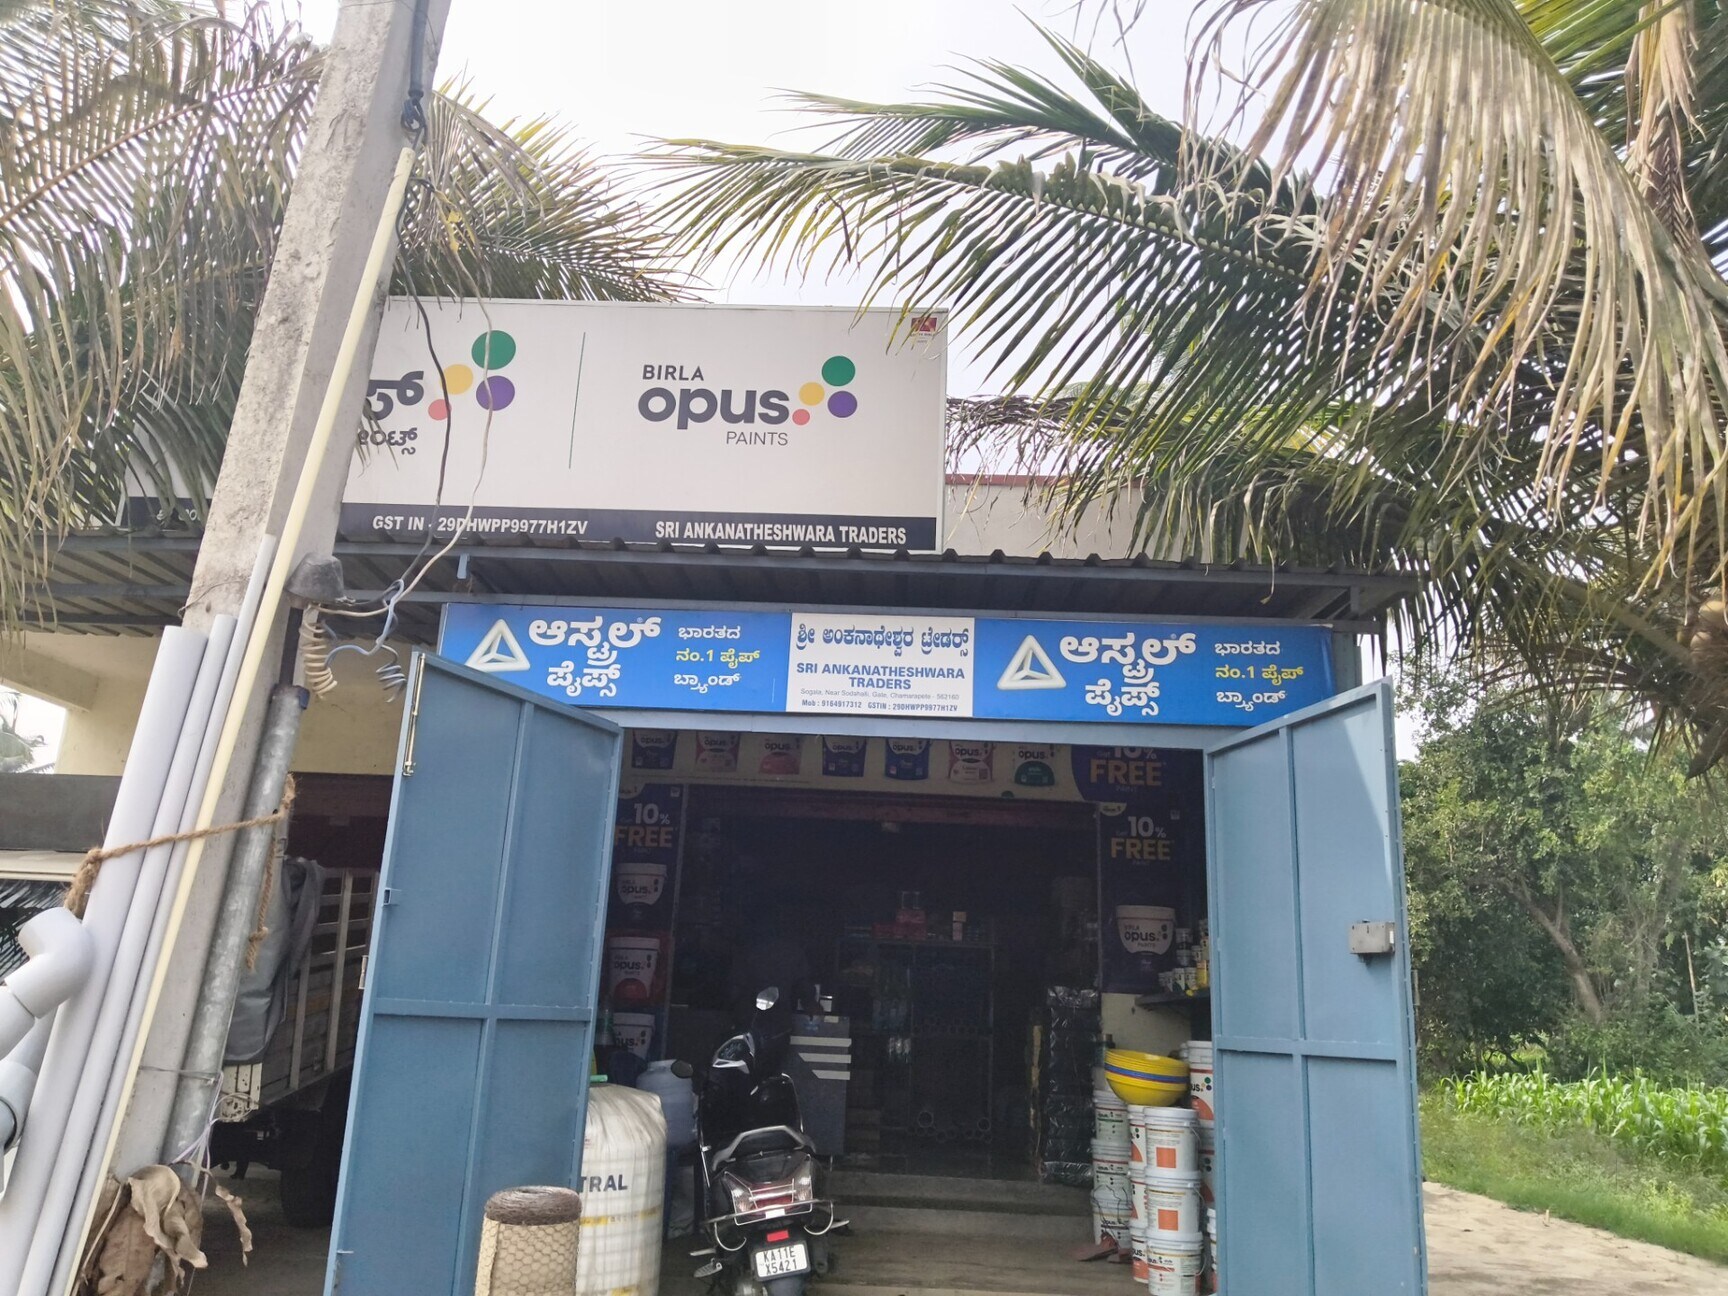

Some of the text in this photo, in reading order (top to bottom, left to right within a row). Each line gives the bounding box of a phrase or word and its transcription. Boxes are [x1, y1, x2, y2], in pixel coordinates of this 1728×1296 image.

[642, 364, 704, 382] BIRLA
[638, 385, 790, 430] opus
[725, 431, 789, 447] PAINTS
[372, 515, 404, 531] GST
[407, 516, 425, 531] IN
[655, 521, 907, 545] SRI ANKANATHESHWARA TRADERS
[528, 615, 662, 667] ಆಸ್ಟ್ರಲ್
[678, 625, 741, 640] ಭಾರತದ
[795, 623, 816, 651] ಶ್ರೀ
[822, 624, 914, 657] ಅಂಕನಾಥೇಶ್ವರ
[1214, 641, 1281, 655] ಭಾರತದ
[676, 648, 761, 670] ನಂ.1 ಪೈಪ್
[1059, 632, 1196, 684] ಆಸ್ಟ್ರಲ್
[546, 660, 621, 698] ಪೈಪ್ಸ್
[796, 662, 965, 679] SRI ANKANATHESHWARA
[1215, 665, 1304, 686] ನಂ.1 ಪೈಪ್
[849, 677, 912, 690] TRADERS
[825, 689, 840, 697] Near
[1084, 678, 1161, 717] ಪೈಪ್ಸ್
[801, 699, 816, 707] Mob
[821, 700, 862, 709] 9164917312
[868, 701, 887, 710] GSTIN
[955, 746, 980, 757] opus
[1019, 749, 1046, 760] opus
[634, 802, 671, 825] 10%
[1128, 816, 1167, 838] 10%
[1124, 931, 1156, 942] opus
[580, 1174, 628, 1193] TRAL
